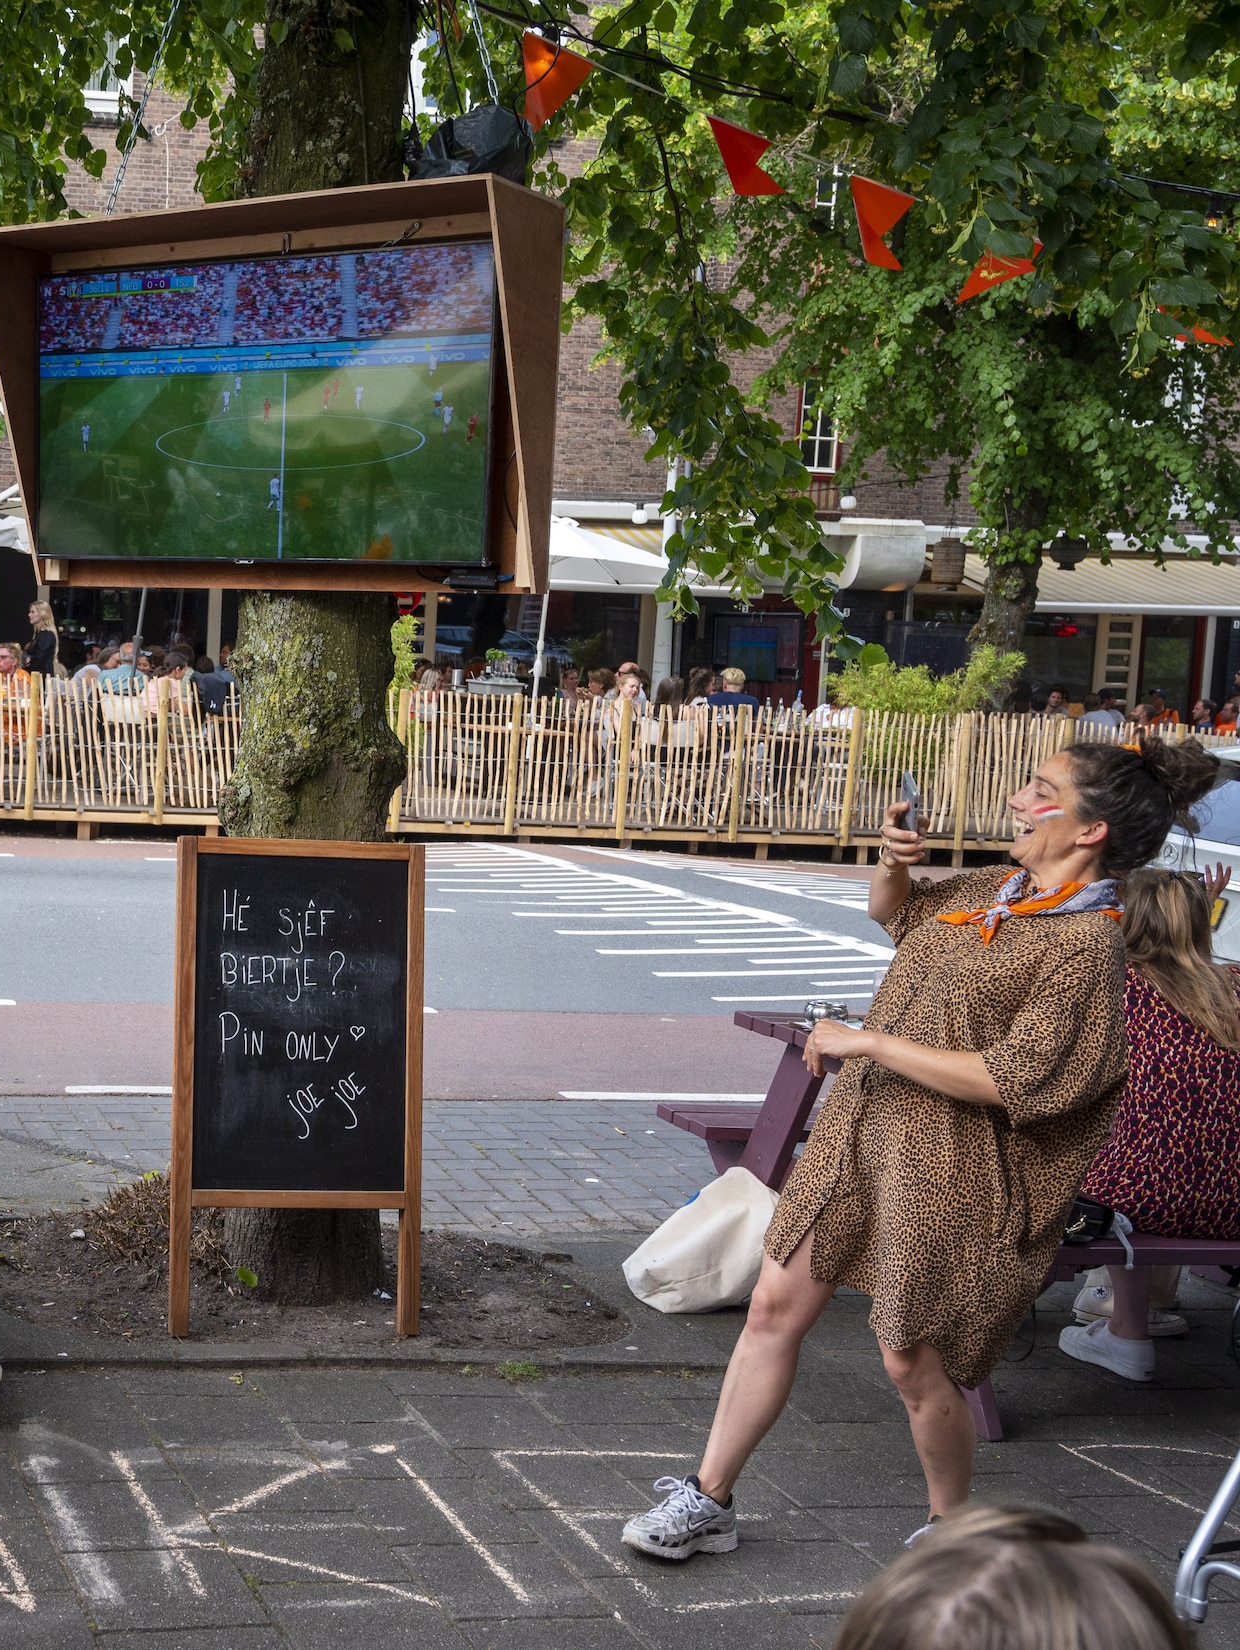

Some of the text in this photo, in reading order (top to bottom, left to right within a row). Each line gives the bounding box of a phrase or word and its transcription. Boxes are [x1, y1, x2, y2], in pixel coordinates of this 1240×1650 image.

[88, 284, 109, 294] 36:11
[122, 282, 139, 291] NED
[175, 278, 189, 287] TSJ
[253, 360, 275, 369] UEFA
[275, 359, 296, 368] EURO
[297, 357, 319, 367] 2020
[286, 1031, 340, 1063] ONLY
